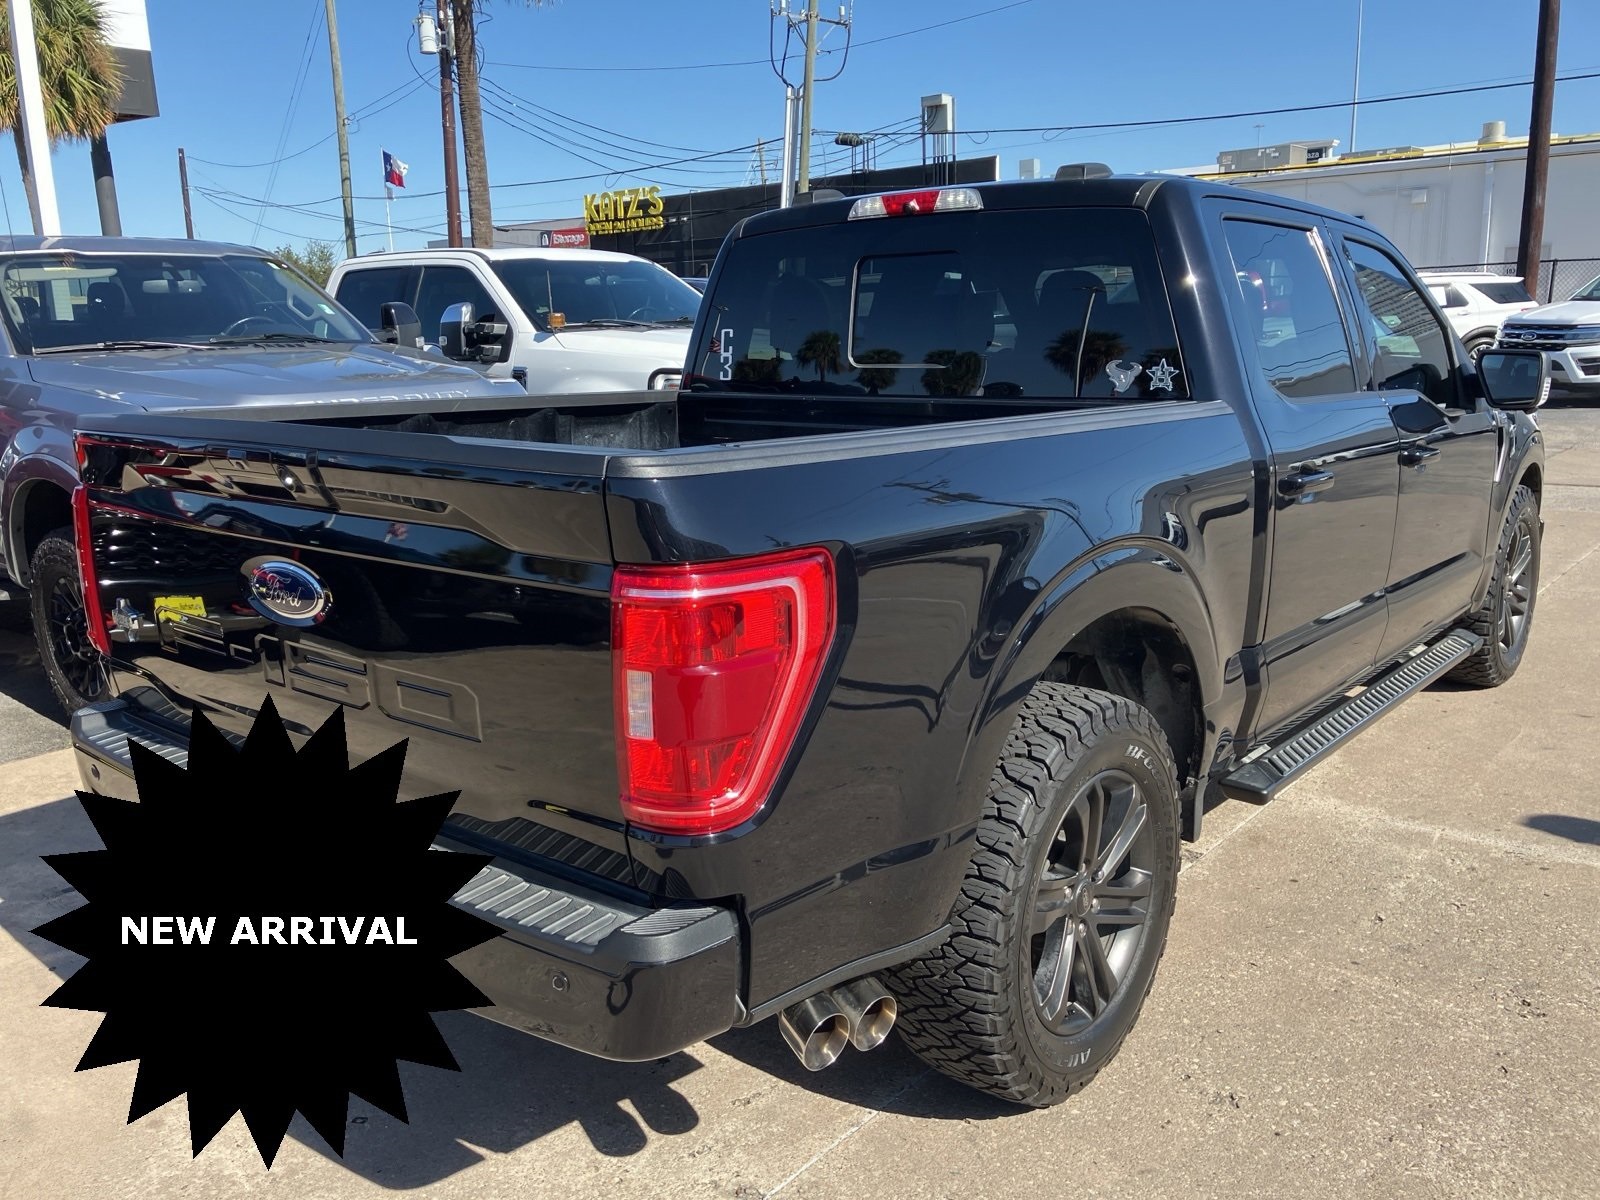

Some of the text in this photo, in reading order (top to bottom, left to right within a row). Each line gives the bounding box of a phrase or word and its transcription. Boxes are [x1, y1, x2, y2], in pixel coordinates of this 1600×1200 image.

[584, 185, 664, 222] KATZ'S
[553, 234, 585, 245] iStorage
[588, 221, 613, 235] OPEN
[626, 216, 664, 232] HOURS
[264, 573, 302, 607] Ford
[154, 605, 482, 743] F-150
